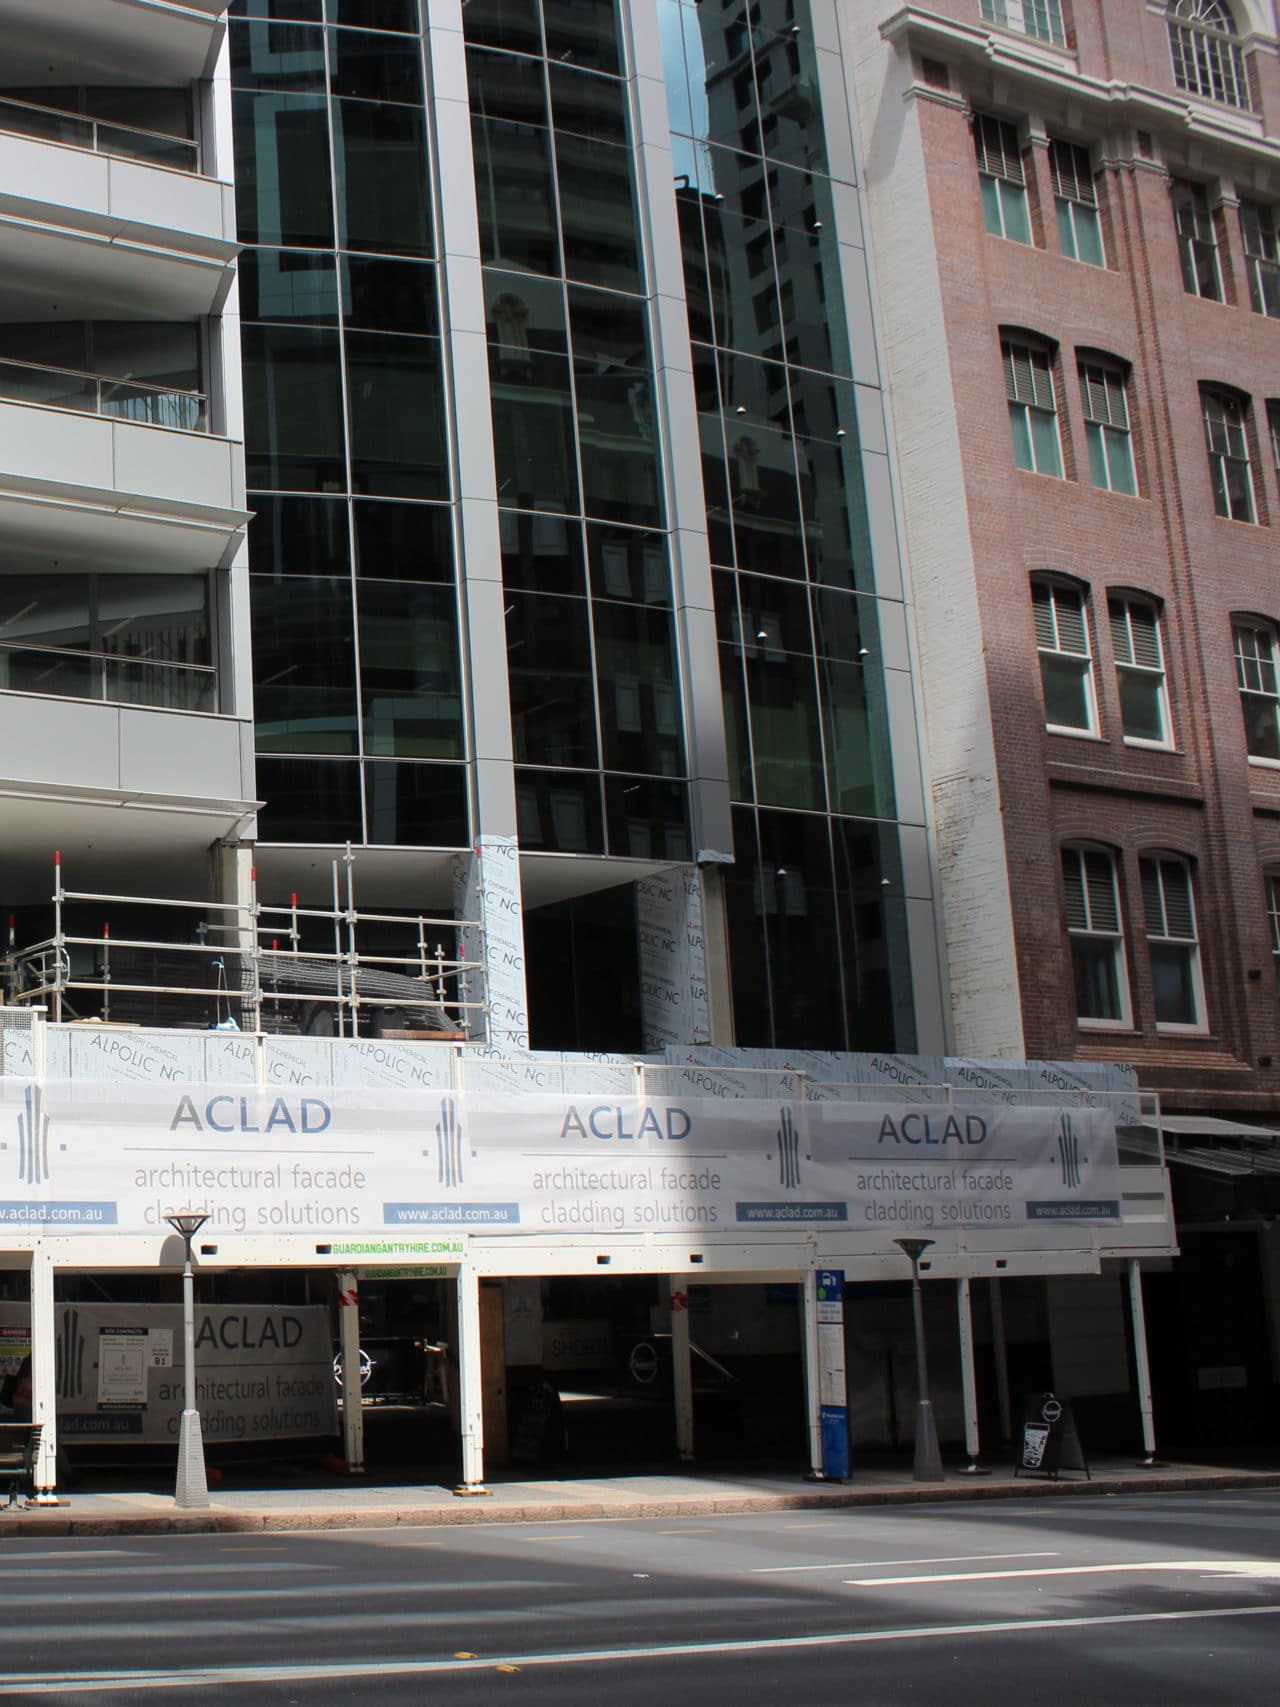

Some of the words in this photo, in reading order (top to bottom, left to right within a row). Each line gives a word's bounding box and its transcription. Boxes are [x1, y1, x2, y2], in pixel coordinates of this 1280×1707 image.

[499, 897, 520, 915] NC
[503, 951, 523, 970] NC
[505, 1008, 526, 1025] NC
[90, 1033, 155, 1072] ALPOLIC
[349, 1043, 406, 1074] ALPOLIC
[410, 1066, 433, 1087] NC
[524, 1067, 546, 1087] NC
[681, 1068, 730, 1098] ALPOLIC
[871, 1057, 913, 1086] ALPOLIC
[170, 1095, 332, 1134] ACLAD
[560, 1105, 692, 1140] ACLAD
[877, 1114, 987, 1145] ACLAD
[134, 1162, 281, 1189] architectural
[291, 1164, 366, 1189] facade
[533, 1167, 652, 1190] architectural
[660, 1168, 720, 1191] facade
[857, 1170, 957, 1191] architectural
[963, 1169, 1013, 1191] facade
[144, 1199, 247, 1232] cladding
[257, 1200, 360, 1226] solutions
[397, 1205, 508, 1221] www.aclad.com.au
[540, 1199, 624, 1229] cladding
[633, 1200, 718, 1224] solutions
[747, 1206, 838, 1219] www.aclad.com.au
[864, 1200, 938, 1226] cladding
[941, 1200, 1010, 1221] solutions
[1035, 1205, 1111, 1217] www.aclad.com.au
[333, 1242, 464, 1255] GUARDIANGANTRYHIRE.COM.AU
[195, 1315, 303, 1349] ACLAD
[276, 1374, 324, 1398] facade
[167, 1409, 245, 1438] cdding
[252, 1407, 320, 1431] solutions
